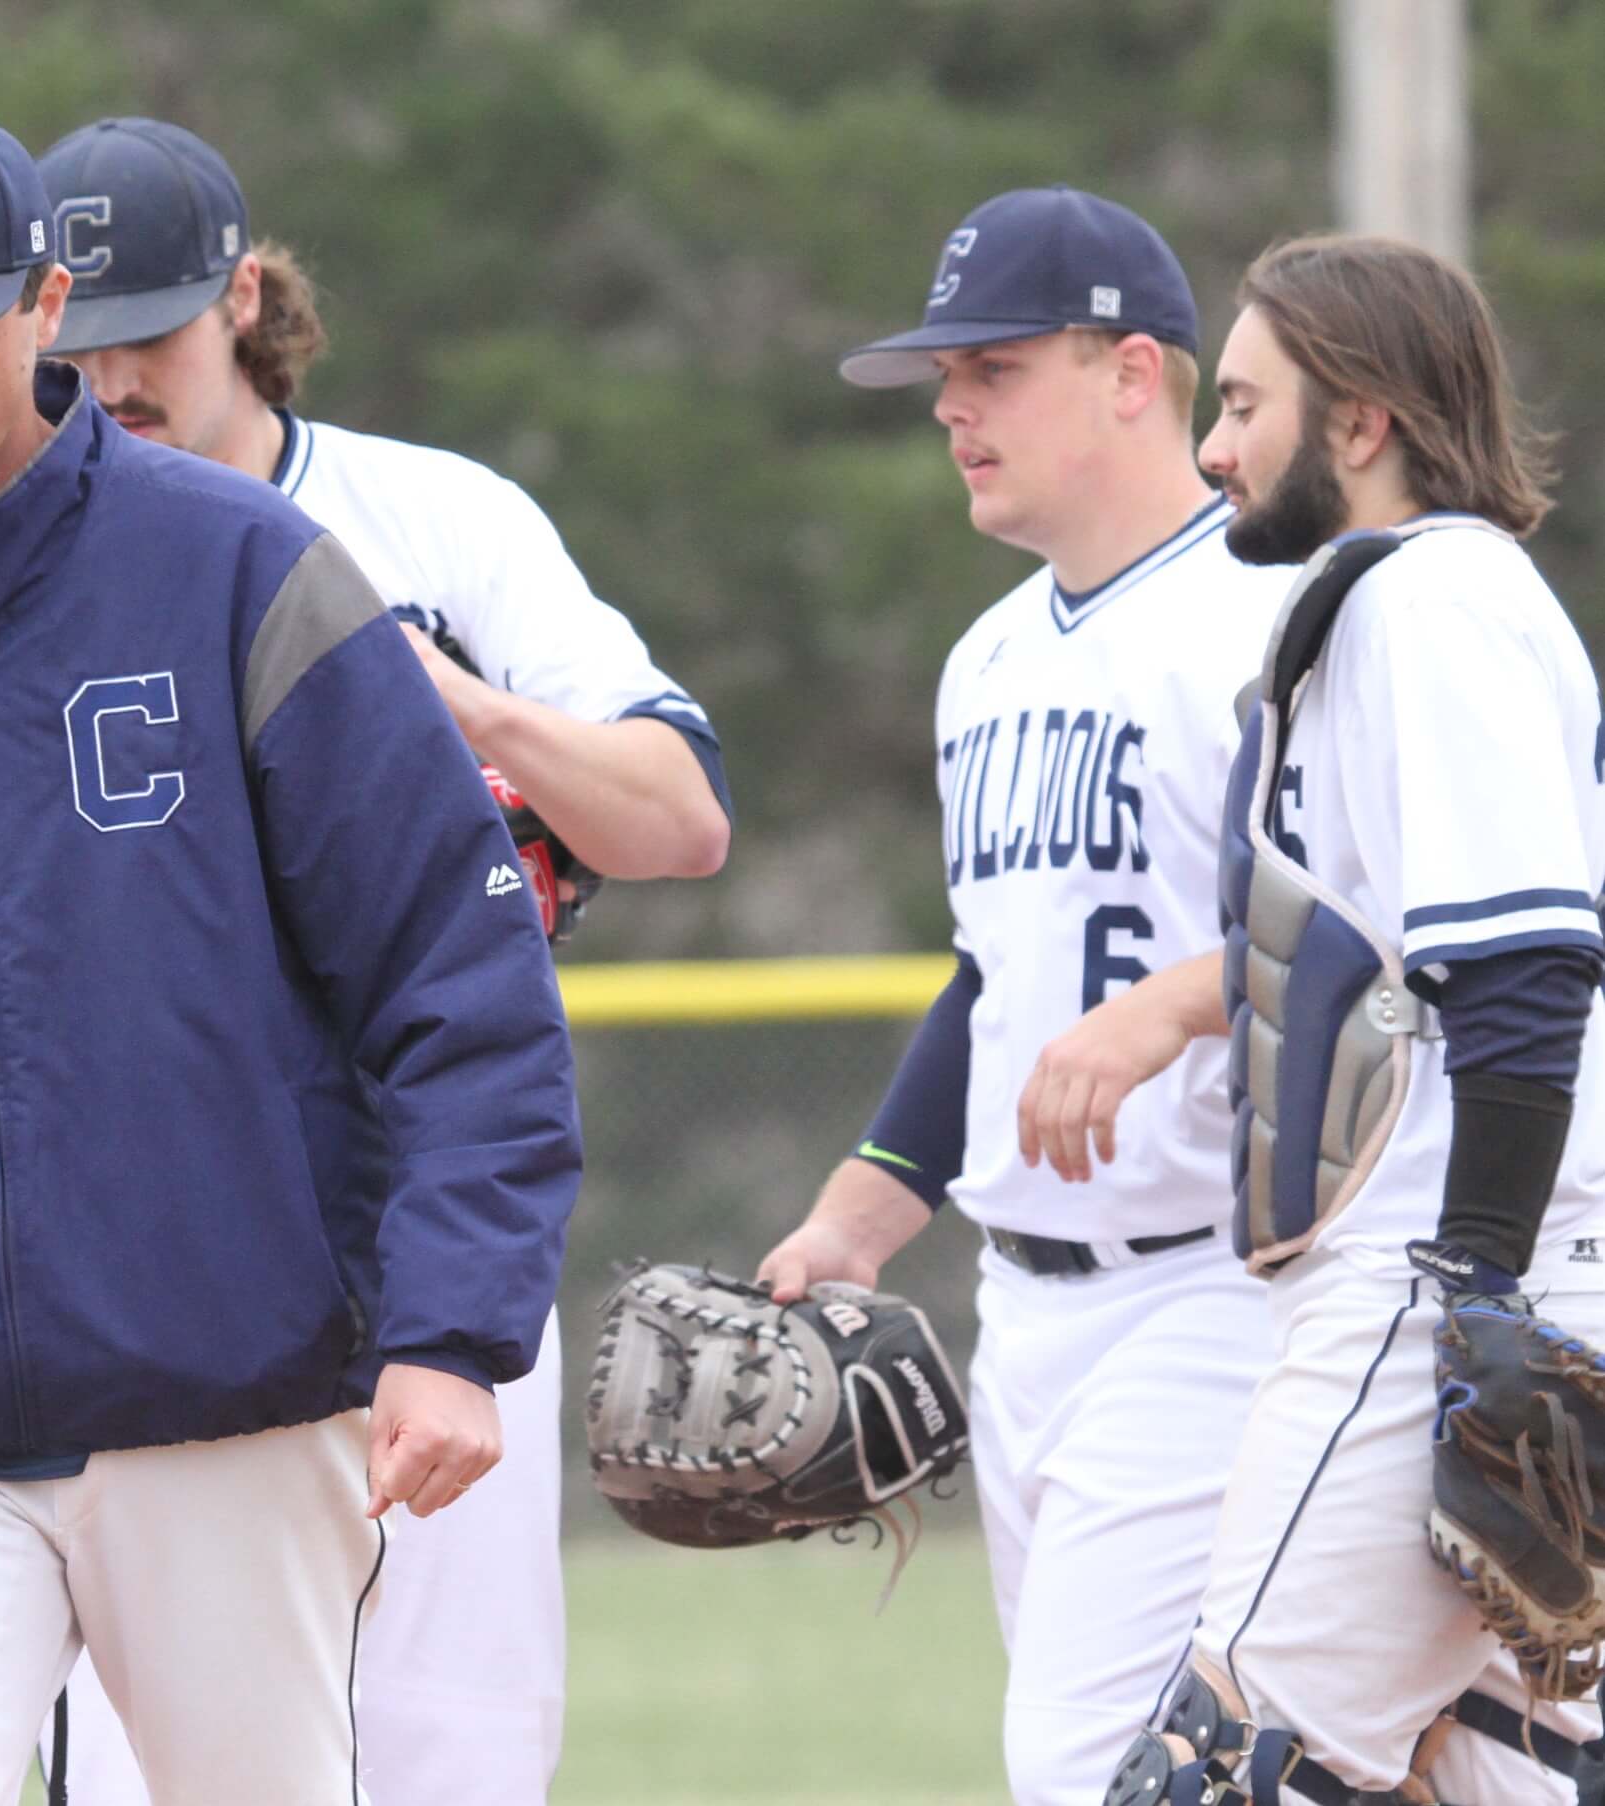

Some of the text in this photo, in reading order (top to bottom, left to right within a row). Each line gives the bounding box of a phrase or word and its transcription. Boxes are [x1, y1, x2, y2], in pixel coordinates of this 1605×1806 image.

[54, 196, 113, 279] C
[63, 671, 185, 833] C
[1082, 903, 1155, 1016] 6
